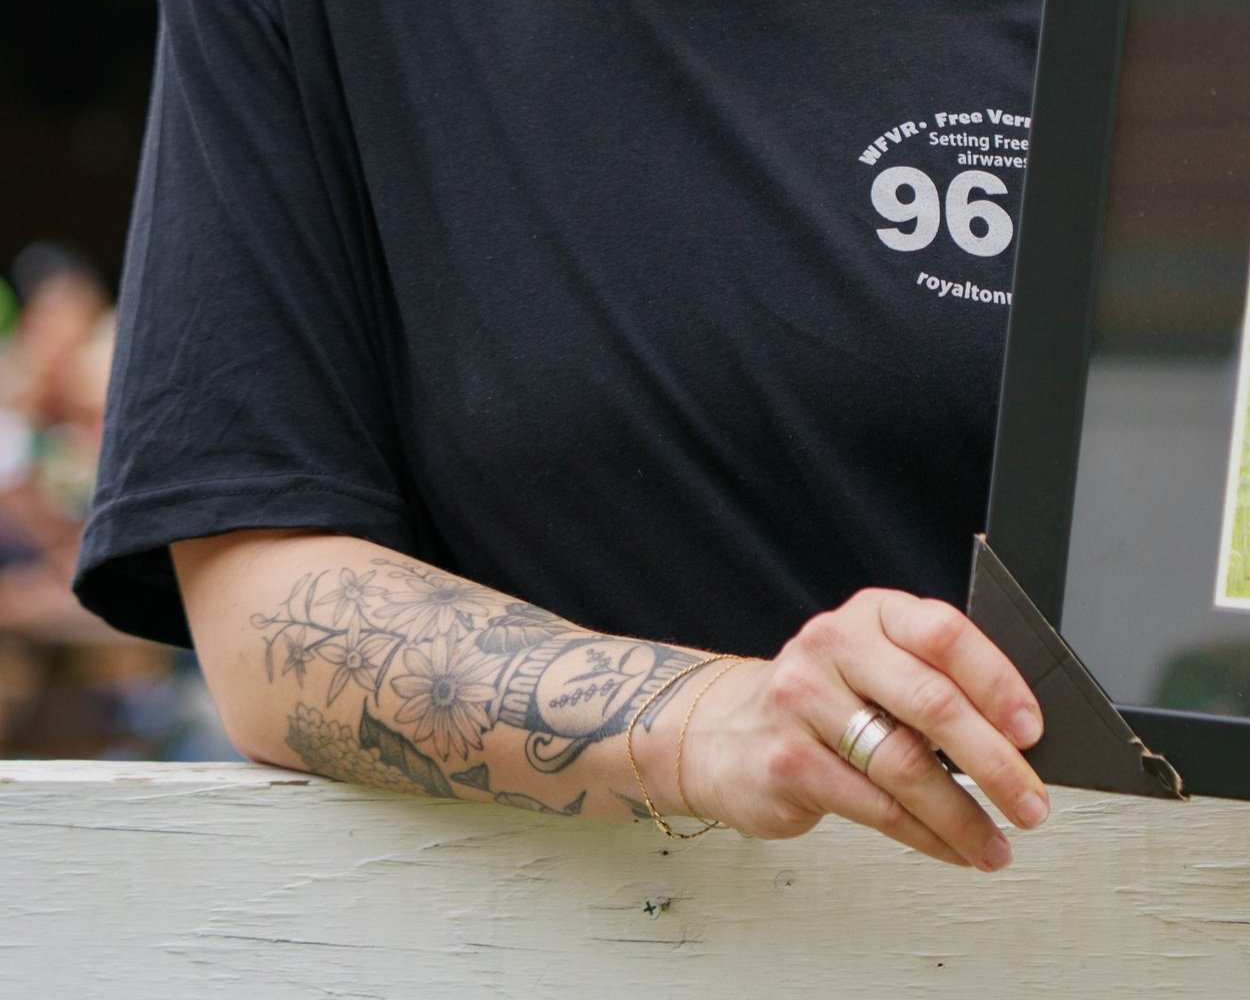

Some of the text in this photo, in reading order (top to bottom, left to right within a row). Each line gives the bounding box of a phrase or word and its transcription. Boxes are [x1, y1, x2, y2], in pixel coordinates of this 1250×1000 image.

[934, 111, 983, 128] Free
[929, 131, 1029, 151] Setting Free
[871, 166, 1014, 257] 96
